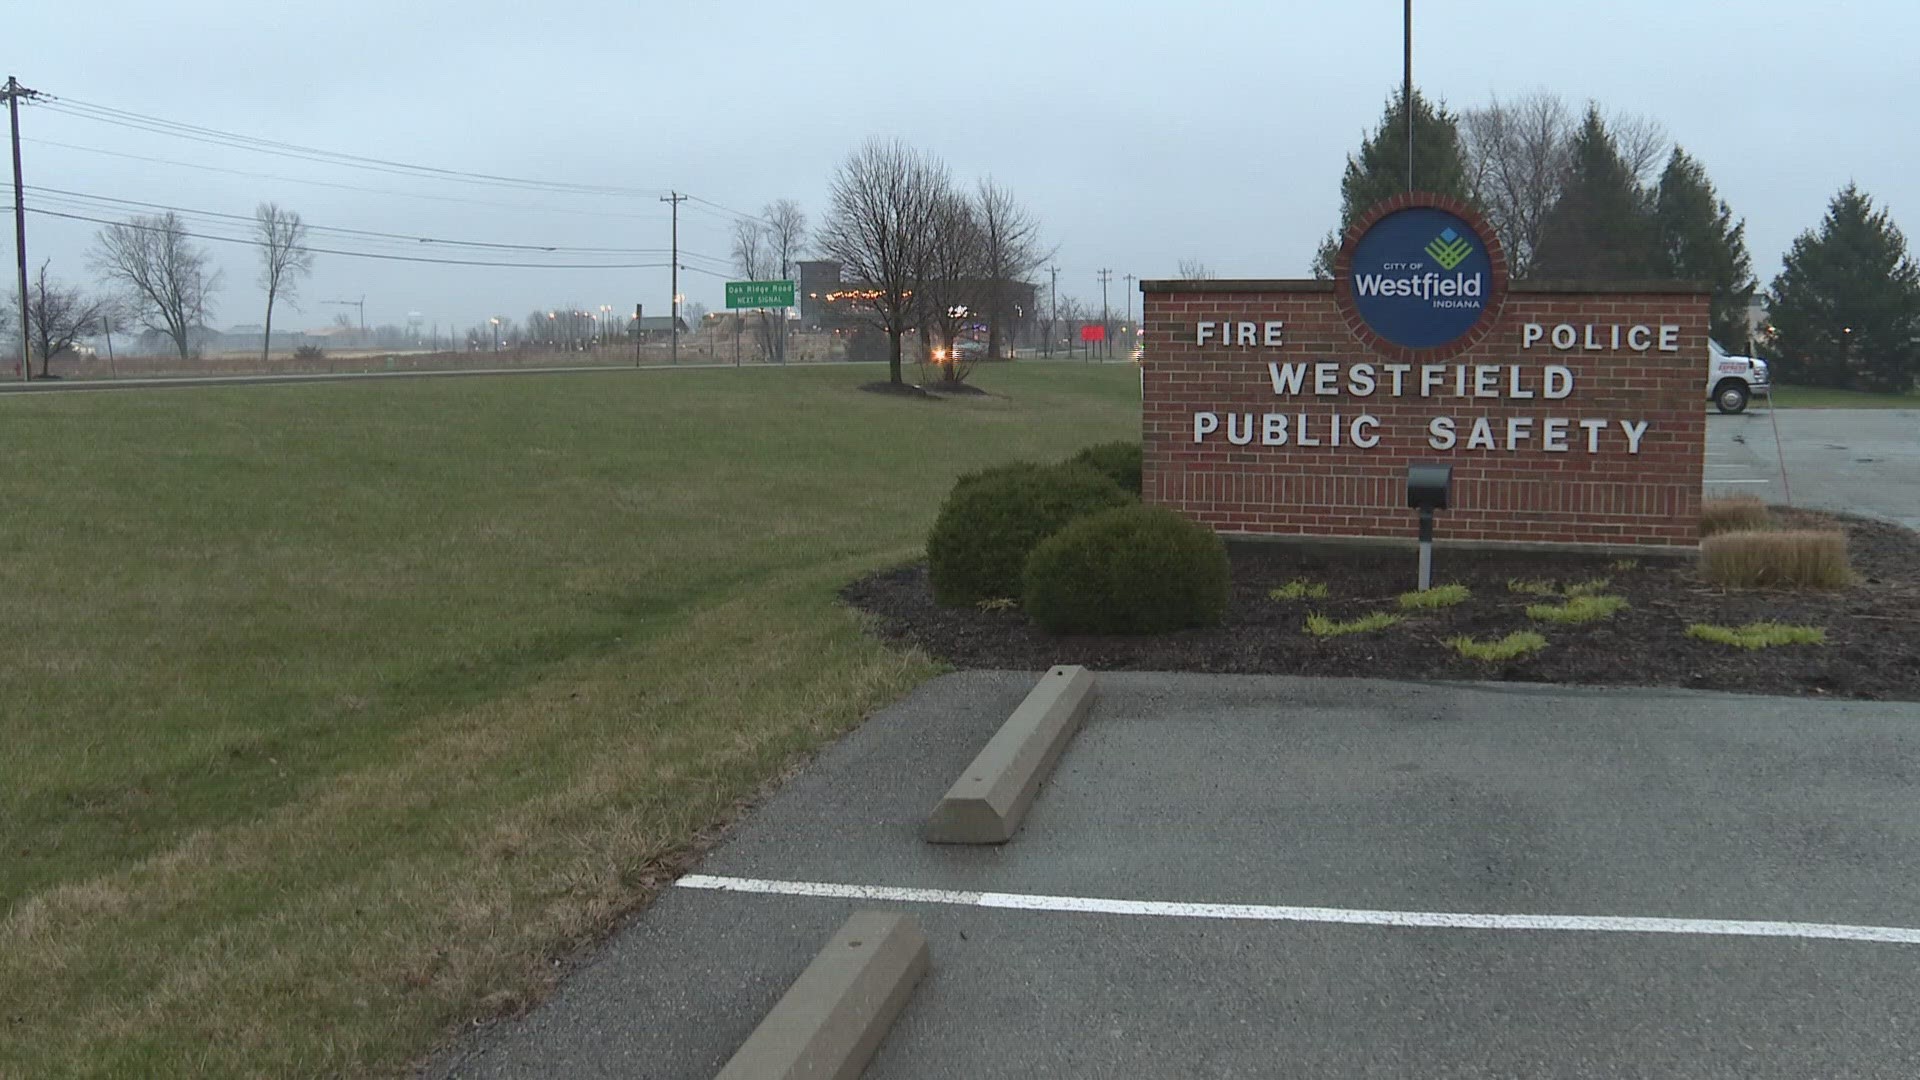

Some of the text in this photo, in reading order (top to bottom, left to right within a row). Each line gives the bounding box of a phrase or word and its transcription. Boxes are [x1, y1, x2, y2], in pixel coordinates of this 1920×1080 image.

[728, 284, 792, 294] Oak Ridge Road
[1355, 272, 1481, 300] Westfield
[758, 295, 782, 304] SIGNAL
[1433, 300, 1480, 308] INDIANA
[1197, 321, 1283, 346] FIRE
[1522, 323, 1680, 351] POLICE
[1268, 362, 1574, 399] WESTFIELD
[1193, 411, 1649, 454] PUBLIC SAFETY
